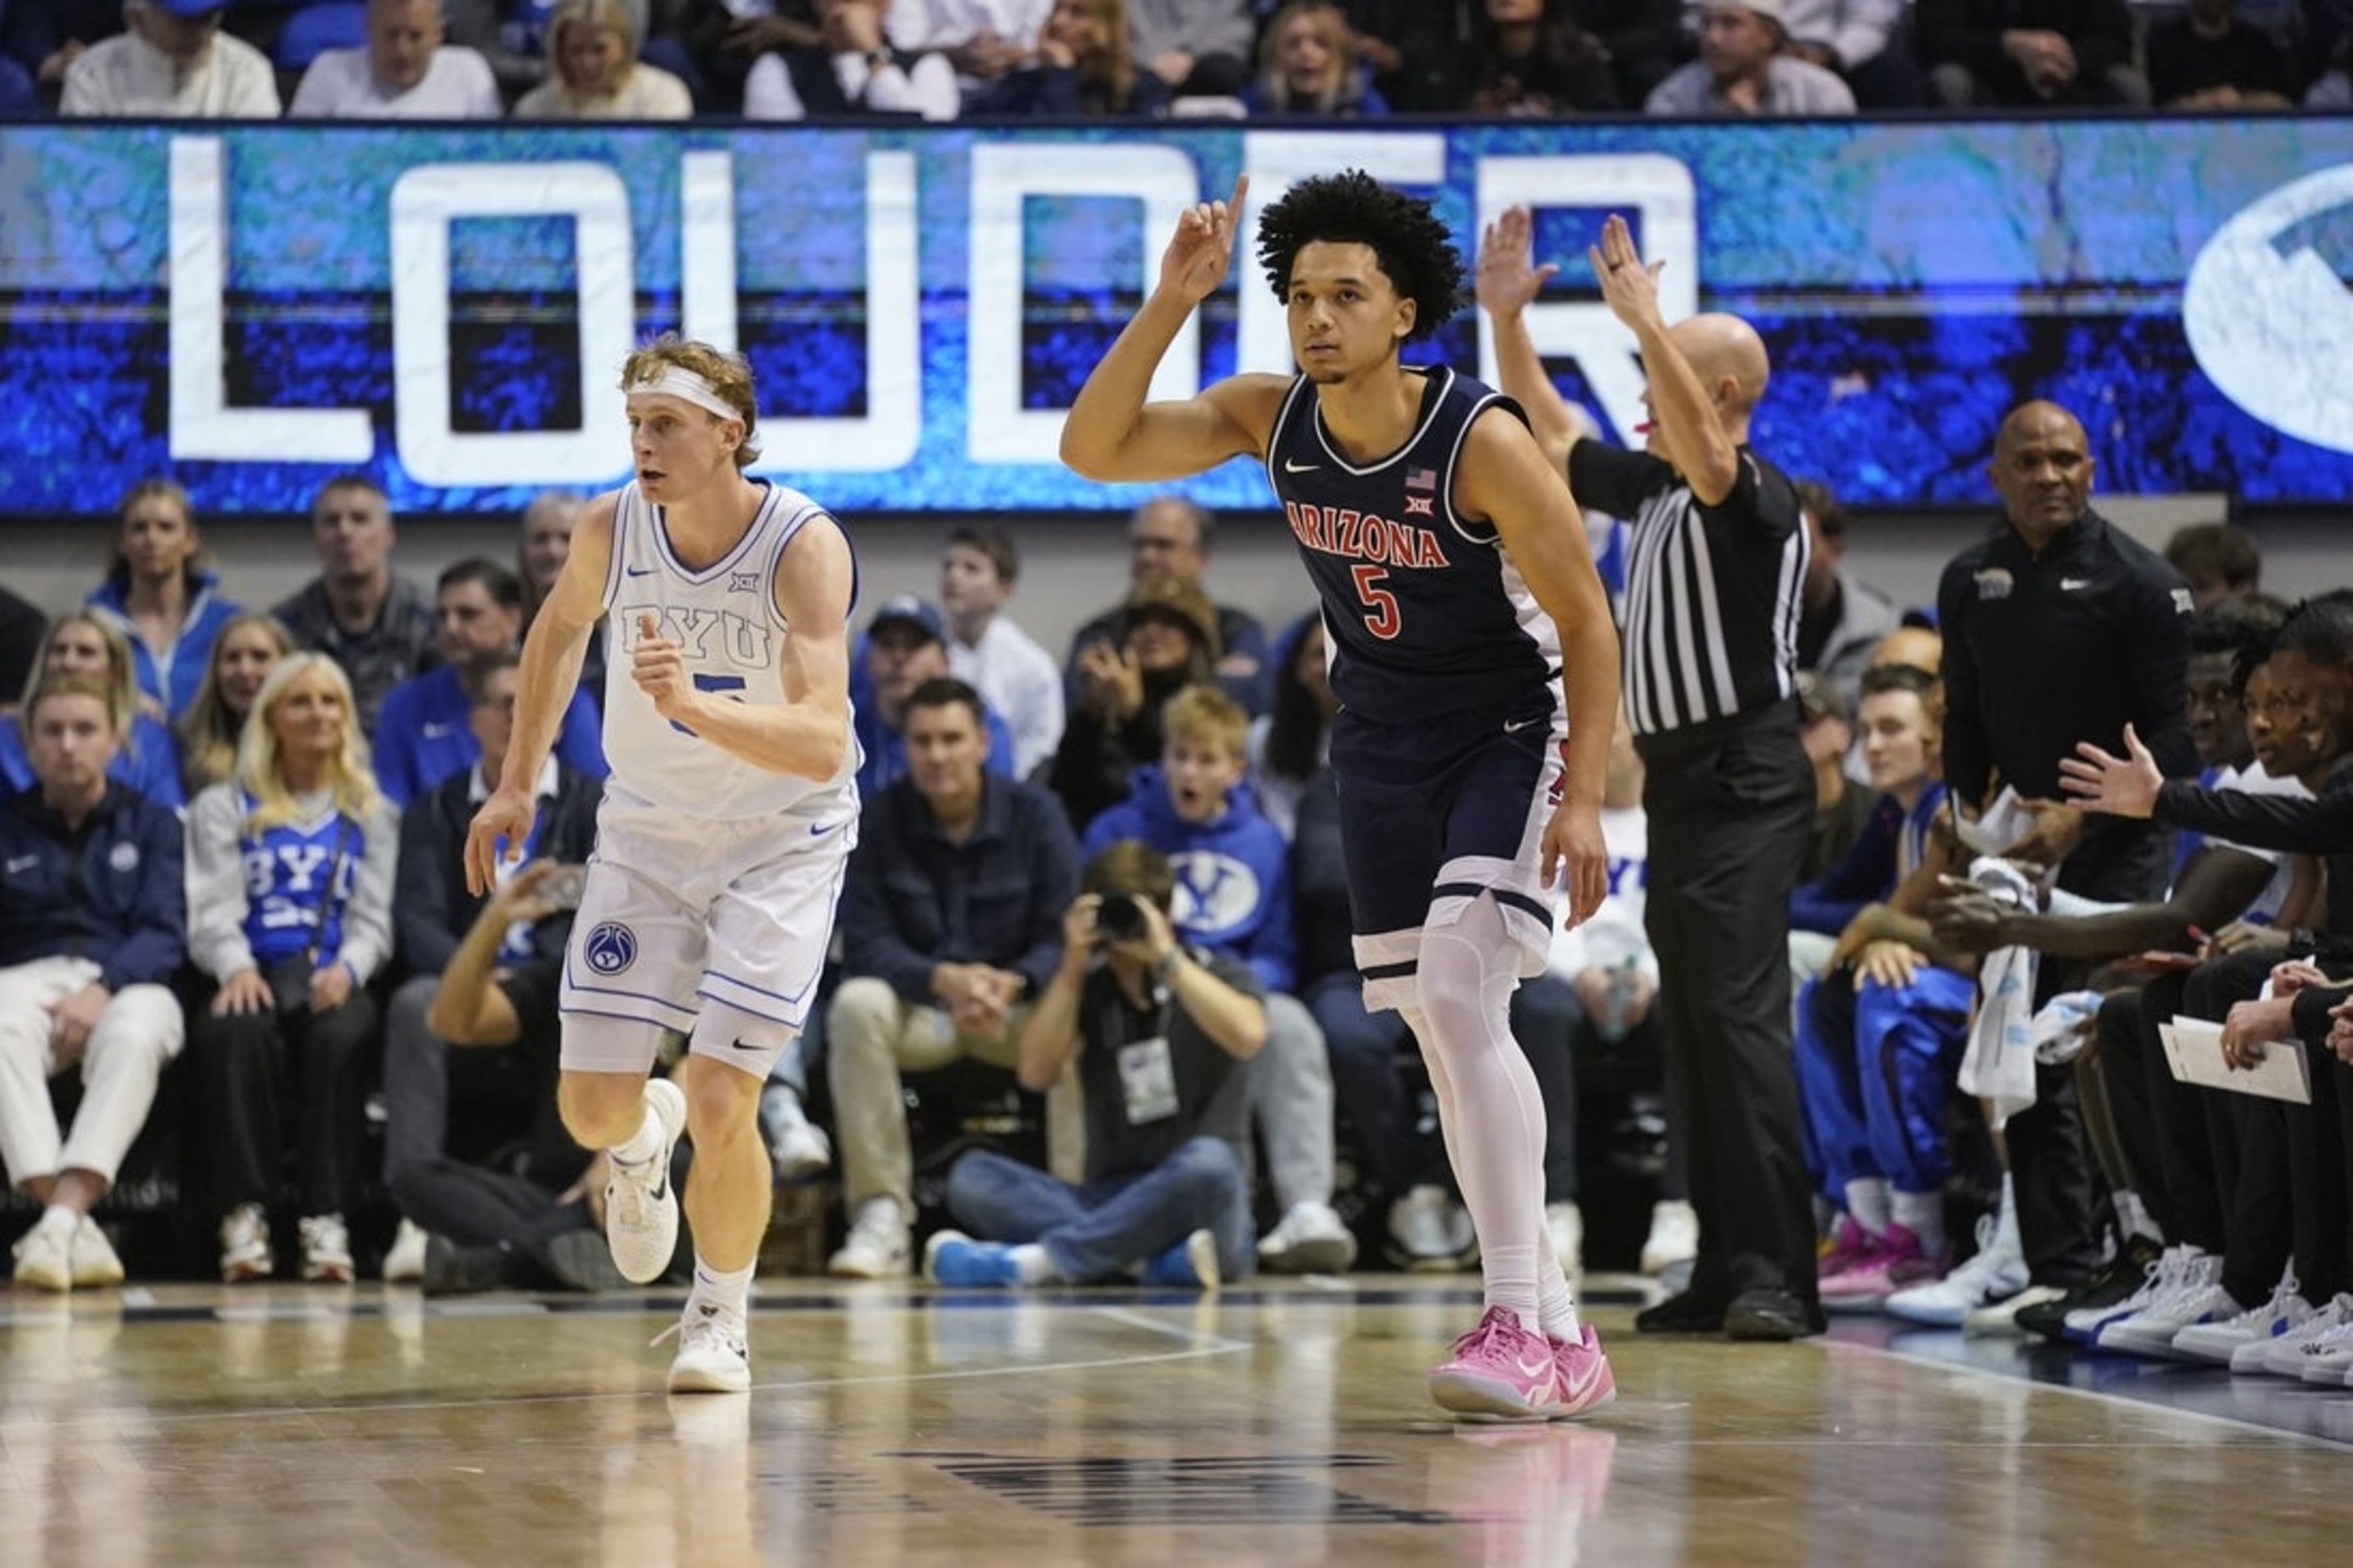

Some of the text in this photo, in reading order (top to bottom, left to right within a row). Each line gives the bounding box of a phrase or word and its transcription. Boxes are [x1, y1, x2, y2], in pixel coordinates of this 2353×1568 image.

[1286, 501, 1450, 568] ARIZONA
[1351, 565, 1401, 640] 5
[622, 605, 770, 669] BYU
